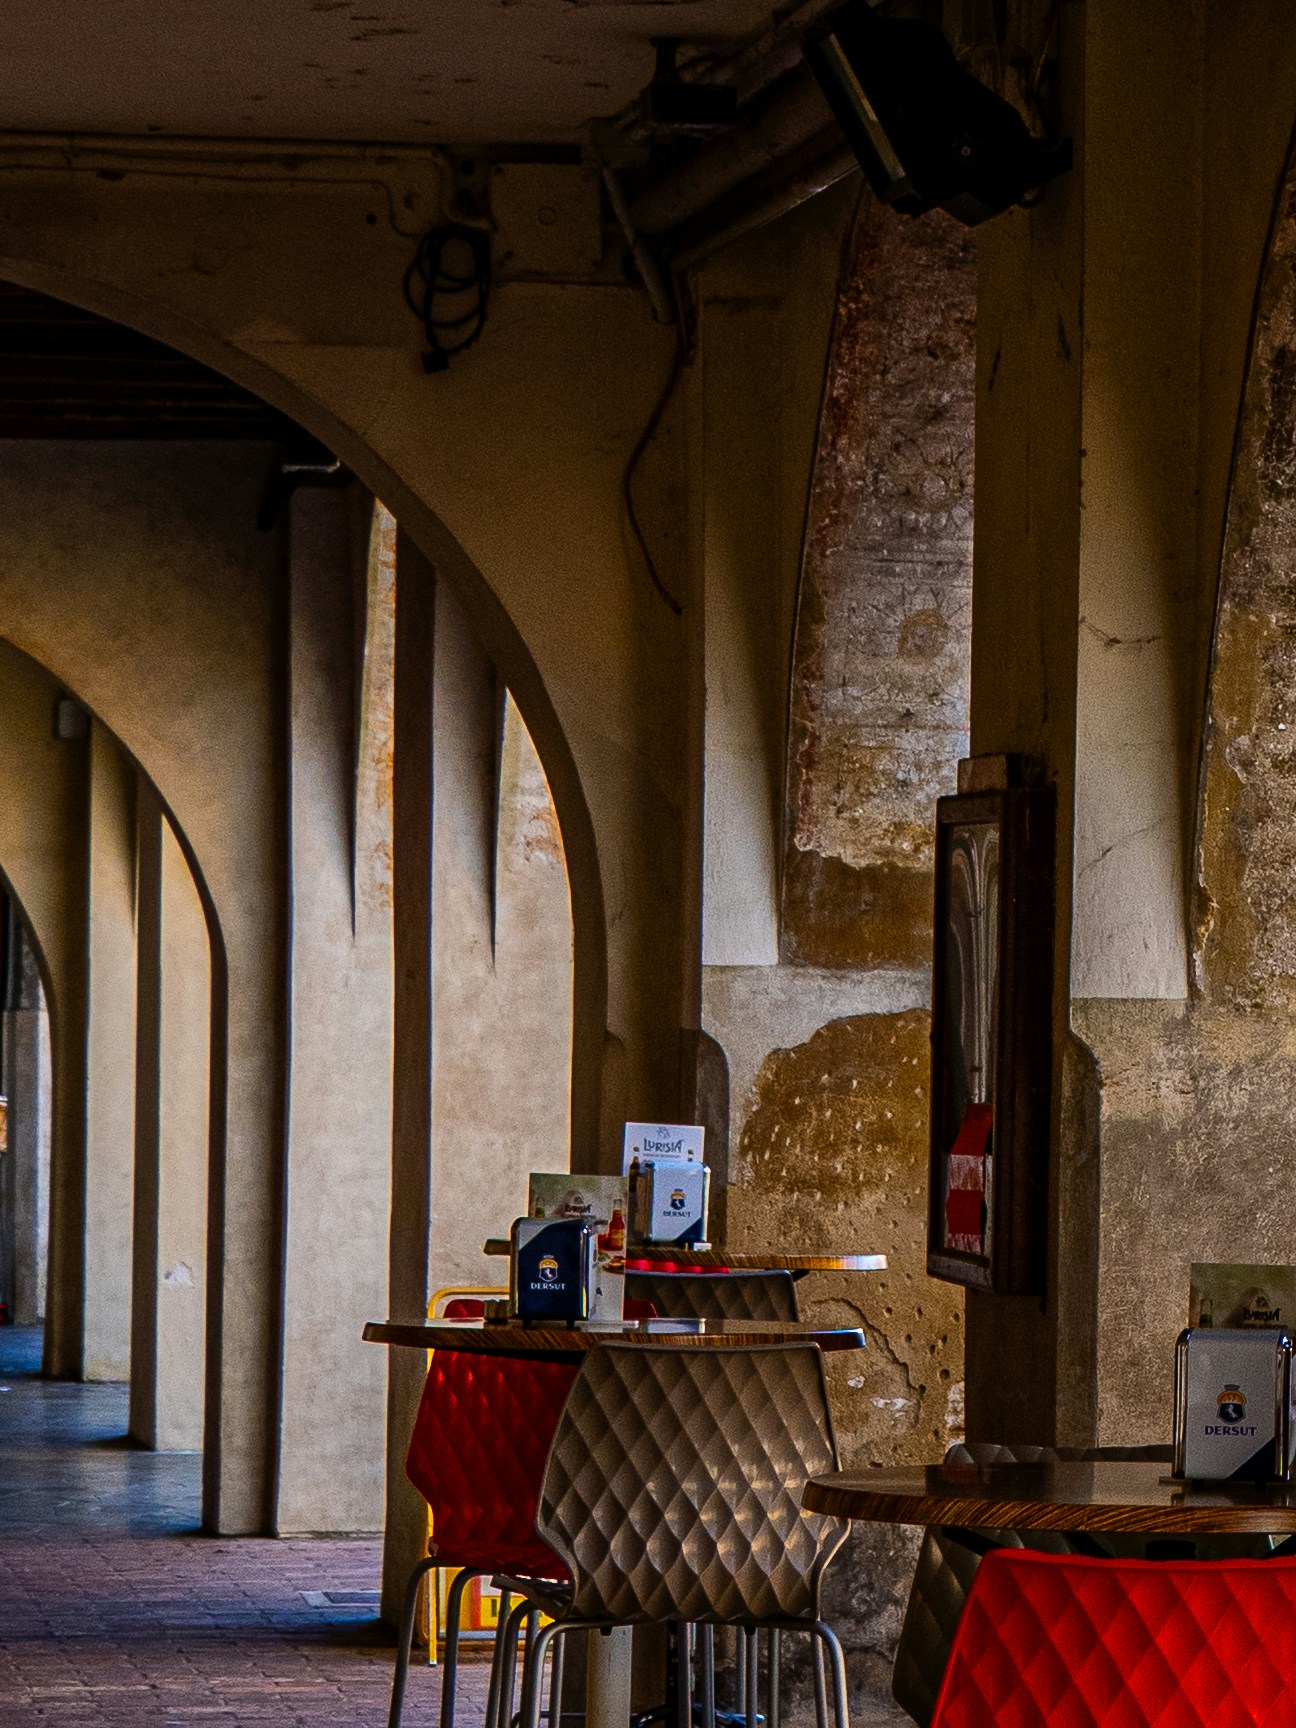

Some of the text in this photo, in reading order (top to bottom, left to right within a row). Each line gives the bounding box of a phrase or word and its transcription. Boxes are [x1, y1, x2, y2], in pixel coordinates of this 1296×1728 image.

[643, 1137, 685, 1153] LURISIA
[662, 1210, 691, 1218] DERSUT
[530, 1282, 566, 1290] DERSUT
[1204, 1425, 1258, 1436] DERSUT
